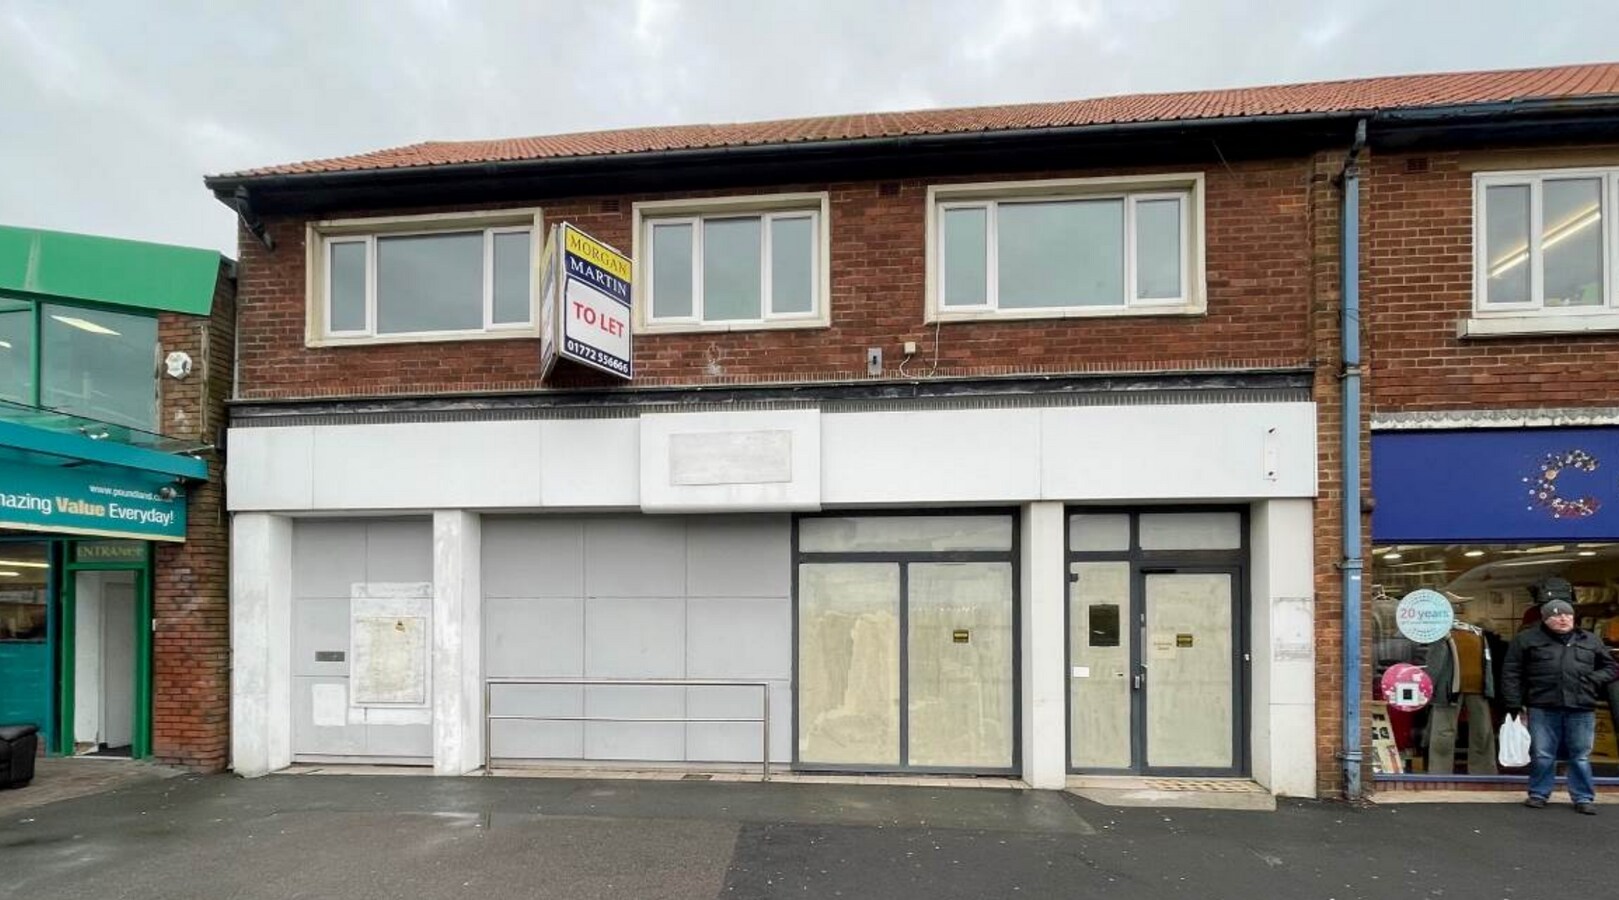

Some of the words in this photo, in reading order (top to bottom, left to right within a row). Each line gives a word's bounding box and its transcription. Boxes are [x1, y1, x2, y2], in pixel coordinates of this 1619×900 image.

[570, 233, 627, 275] MORGAN
[570, 256, 627, 297] MARTIN
[573, 301, 596, 325] TO
[600, 313, 624, 338] LET
[567, 340, 596, 361] 01772
[598, 352, 628, 373] 556666
[55, 496, 105, 517] Value
[109, 503, 174, 526] Everyday!
[1401, 608, 1415, 619] 20
[1417, 609, 1449, 620] years
